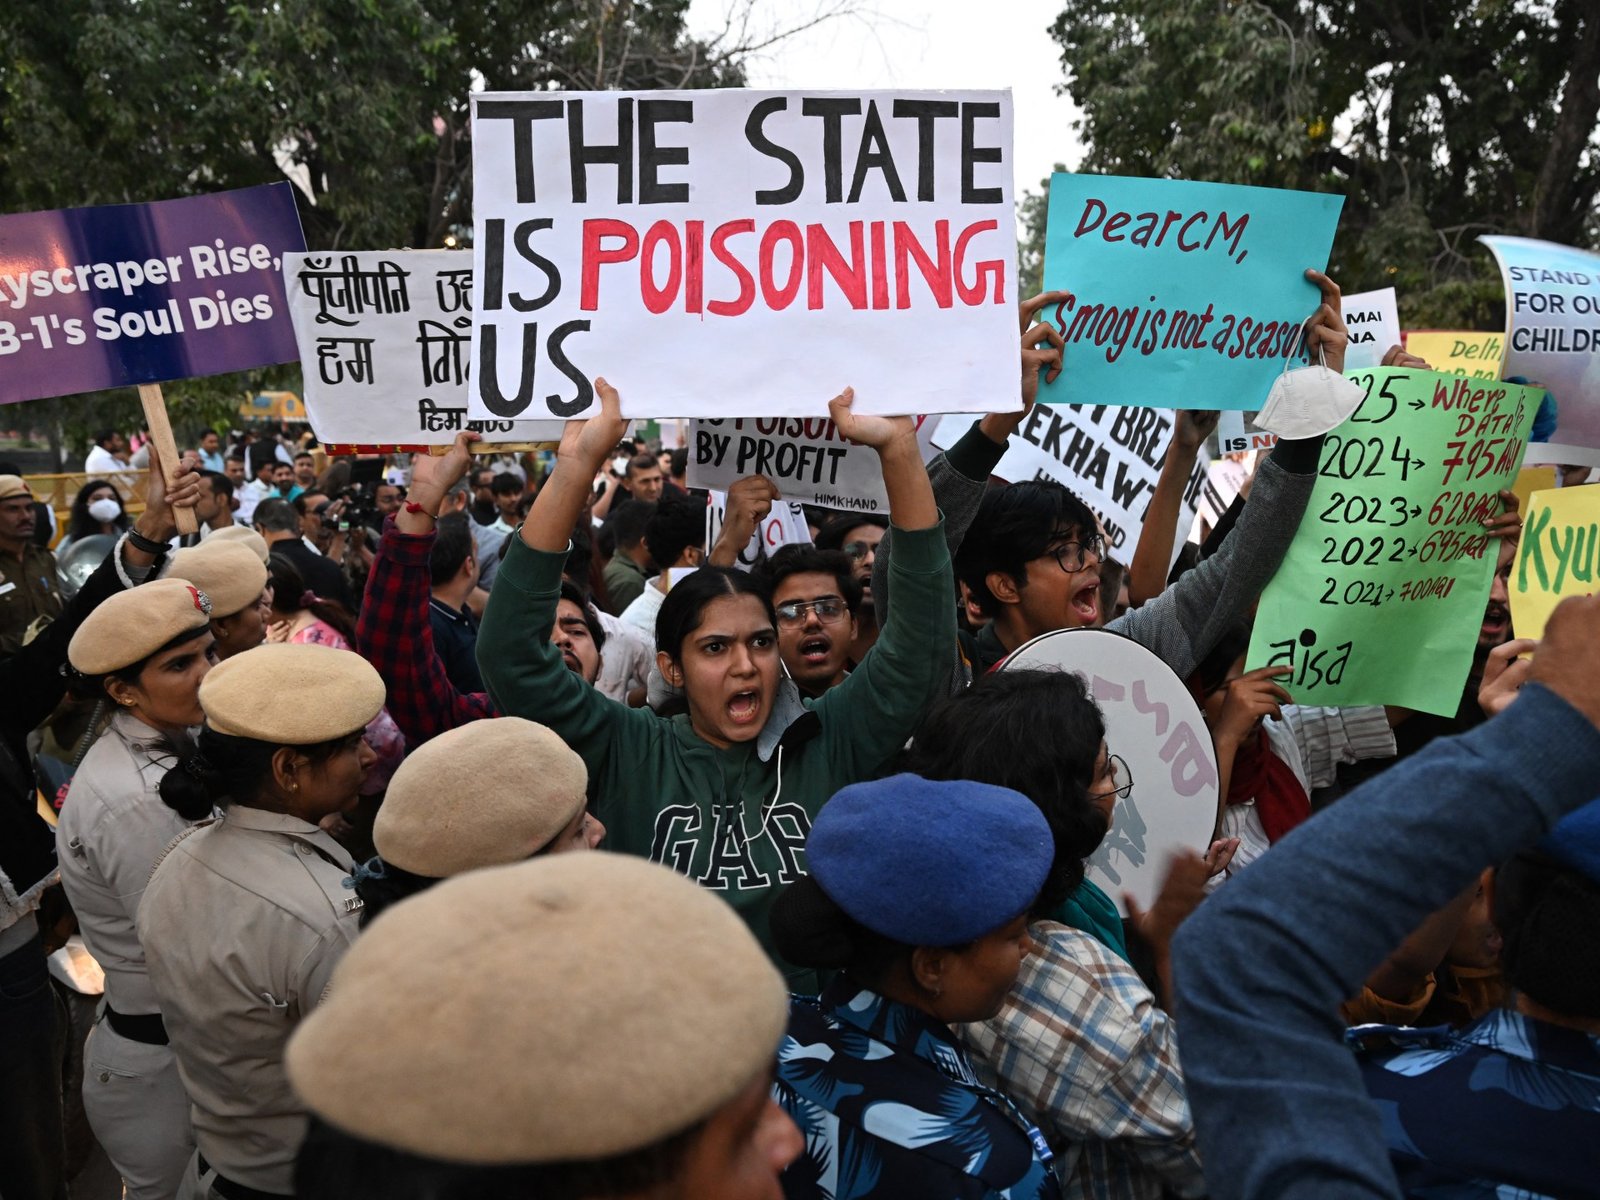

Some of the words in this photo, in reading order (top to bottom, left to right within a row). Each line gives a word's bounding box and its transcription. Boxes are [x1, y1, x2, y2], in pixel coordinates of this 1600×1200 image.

[477, 98, 694, 204] THE
[745, 97, 1003, 204] STATE
[0, 256, 182, 310] yscraper
[189, 238, 281, 279] Rise,
[483, 218, 562, 312] IS
[580, 218, 1005, 318] POISONING
[1509, 266, 1590, 286] STAND
[92, 299, 184, 341] Soul
[189, 289, 273, 330] Dies
[1346, 311, 1382, 325] MAI
[1514, 292, 1565, 313] FOR
[316, 337, 375, 385] हम
[479, 320, 594, 417] US
[1350, 374, 1410, 424] 25
[696, 431, 731, 467] BY
[737, 436, 847, 484] PROFIT
[1224, 437, 1247, 452] IS
[1320, 435, 1410, 481] 2024
[814, 493, 878, 511] HIMKHAND
[1320, 492, 1408, 526] 2023
[1321, 537, 1406, 565] 2022
[1518, 506, 1600, 594] Kyu
[1320, 577, 1384, 607] 2021
[1266, 628, 1352, 690] aisa
[650, 802, 812, 890] GAP
